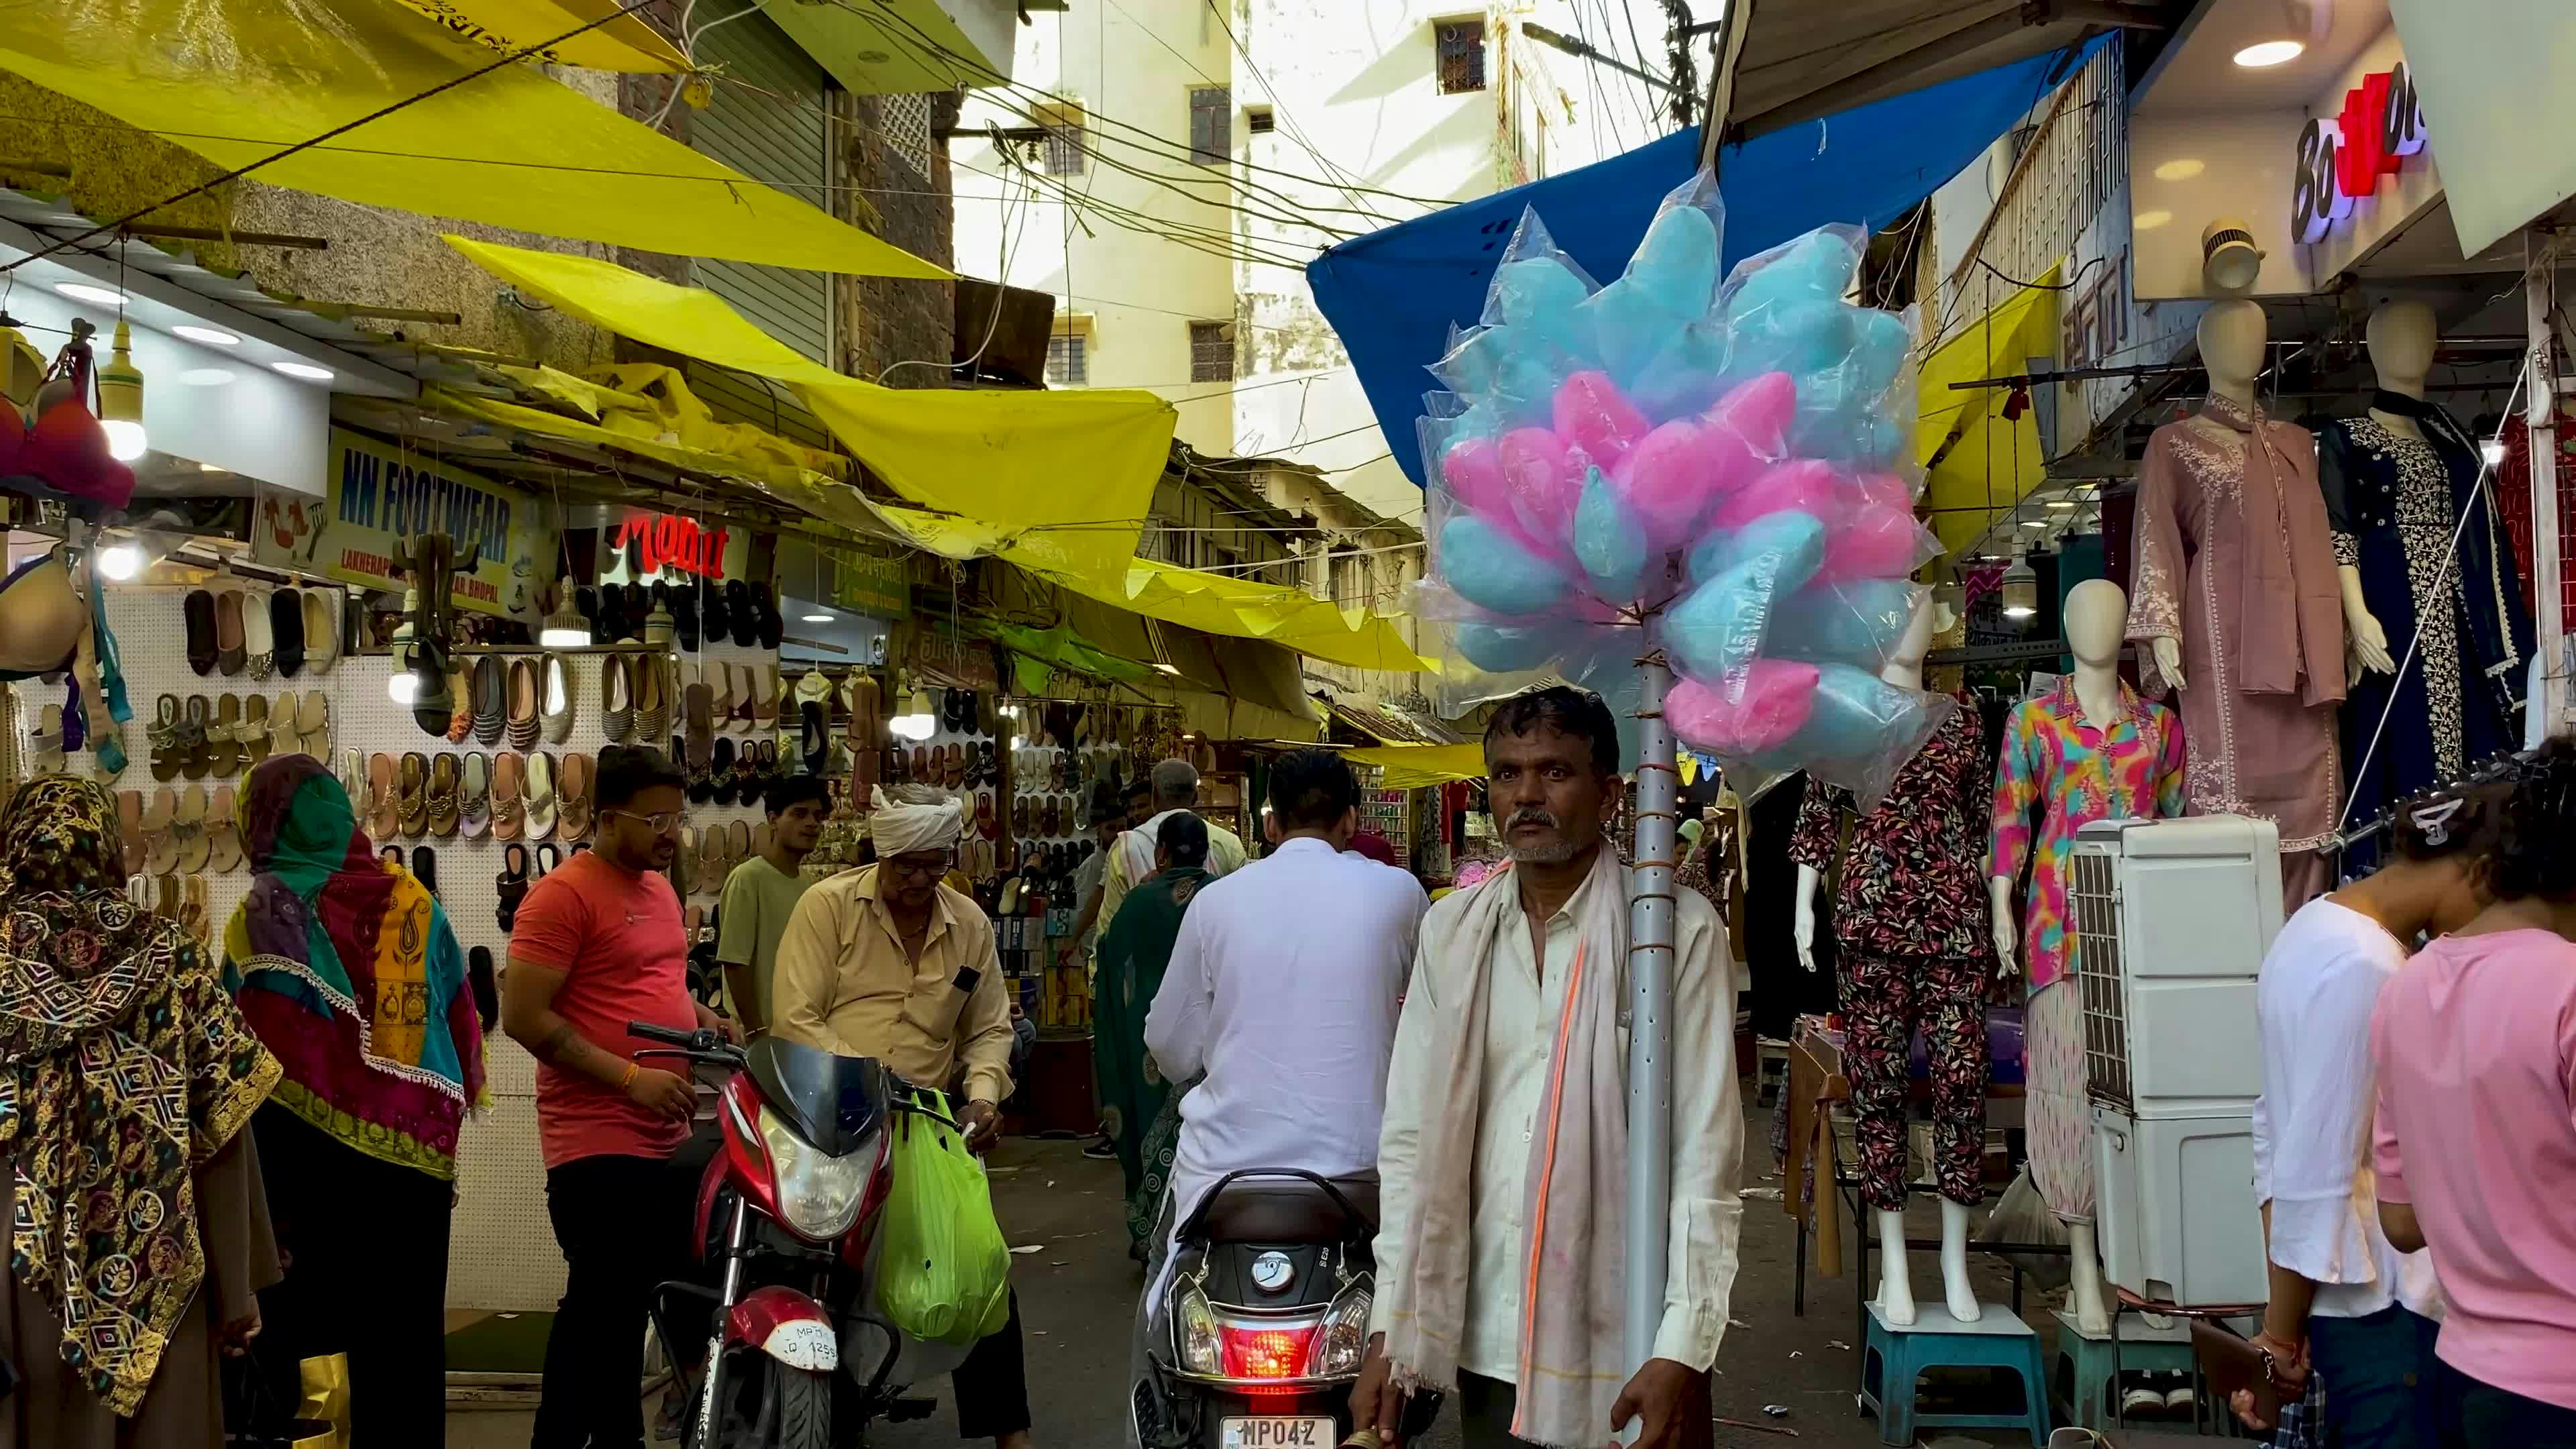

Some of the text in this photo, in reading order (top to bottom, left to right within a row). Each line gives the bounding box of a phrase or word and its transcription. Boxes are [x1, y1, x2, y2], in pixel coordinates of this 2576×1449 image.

[339, 447, 510, 564] NN FOOTWEAR
[468, 580, 498, 603] BHOPAL
[1321, 1247, 1329, 1260] E20
[1242, 1420, 1316, 1446] MP04Z
